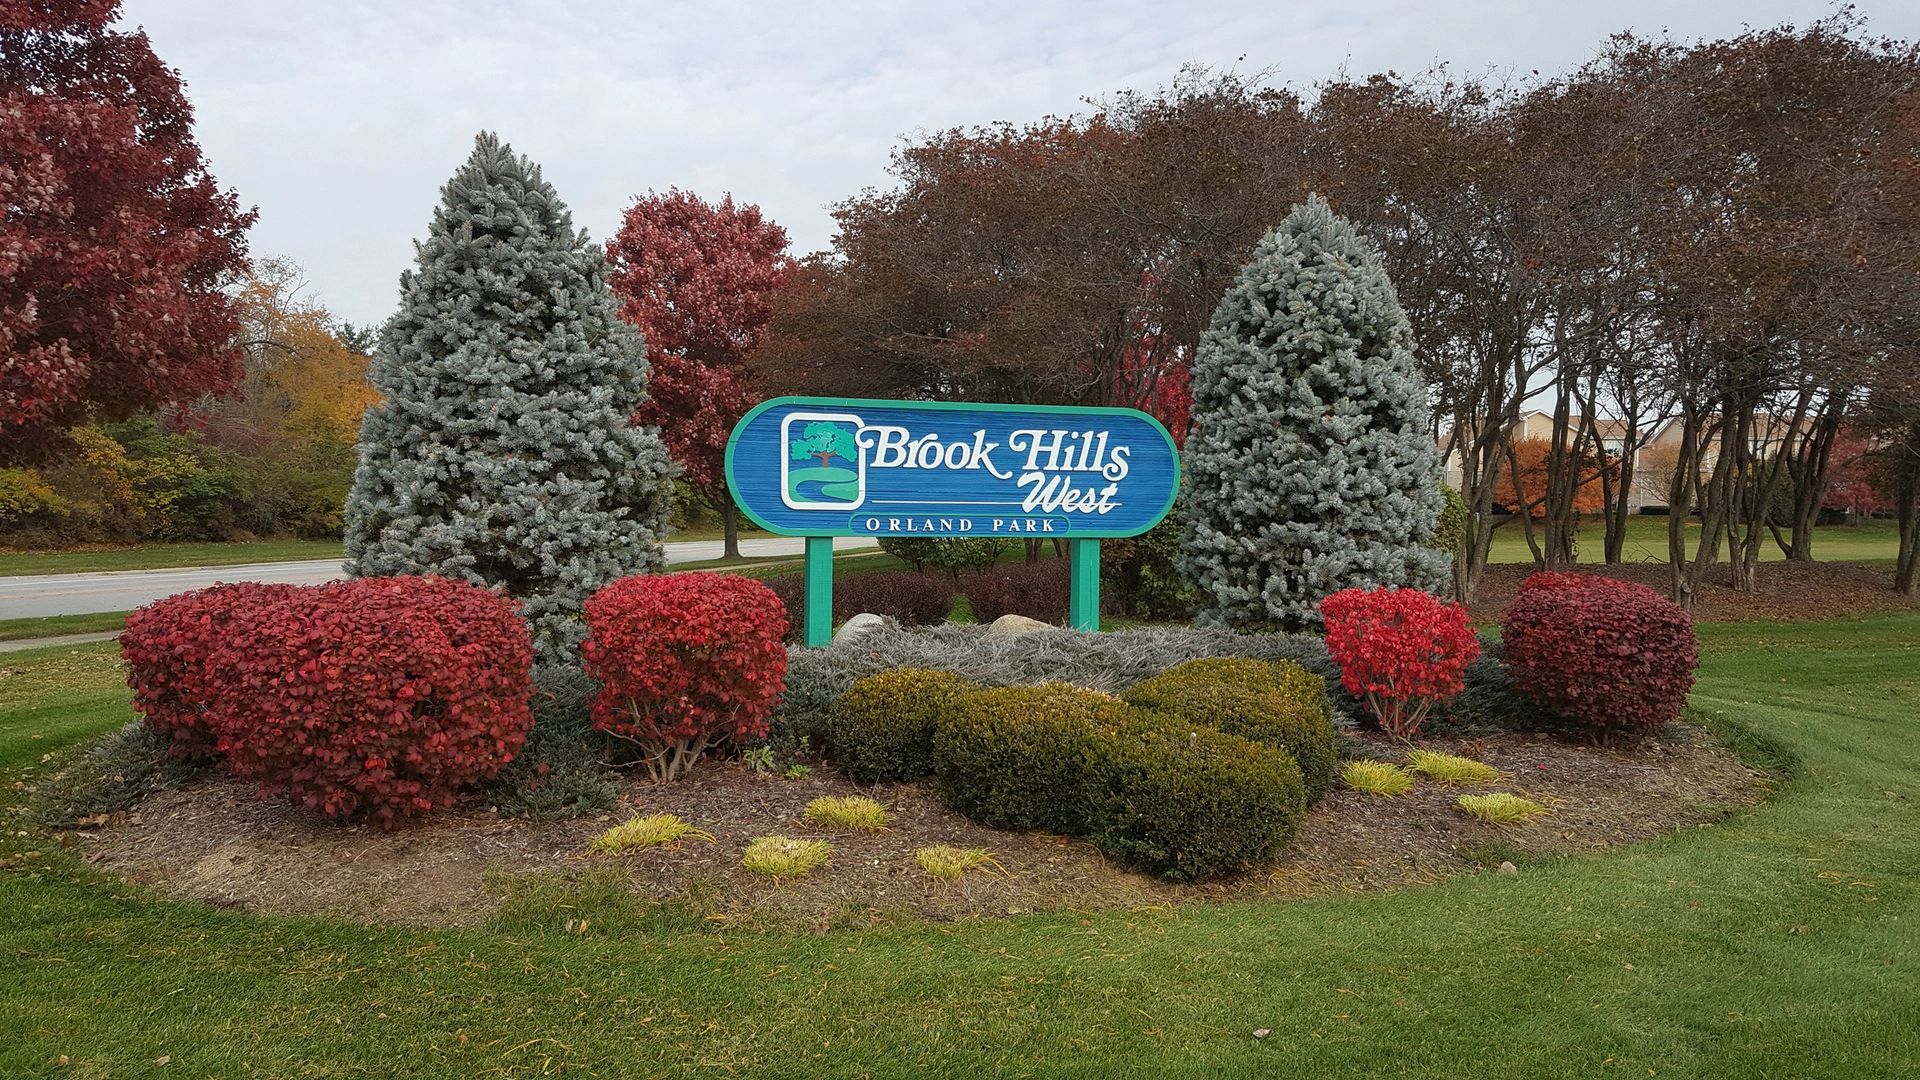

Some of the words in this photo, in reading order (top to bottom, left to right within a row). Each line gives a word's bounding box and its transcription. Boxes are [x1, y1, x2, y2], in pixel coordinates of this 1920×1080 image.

[854, 425, 1013, 480] Brook
[1008, 429, 1130, 481] Hills
[1016, 471, 1120, 514] West
[866, 517, 973, 532] ORLAND
[992, 518, 1055, 532] PARK
